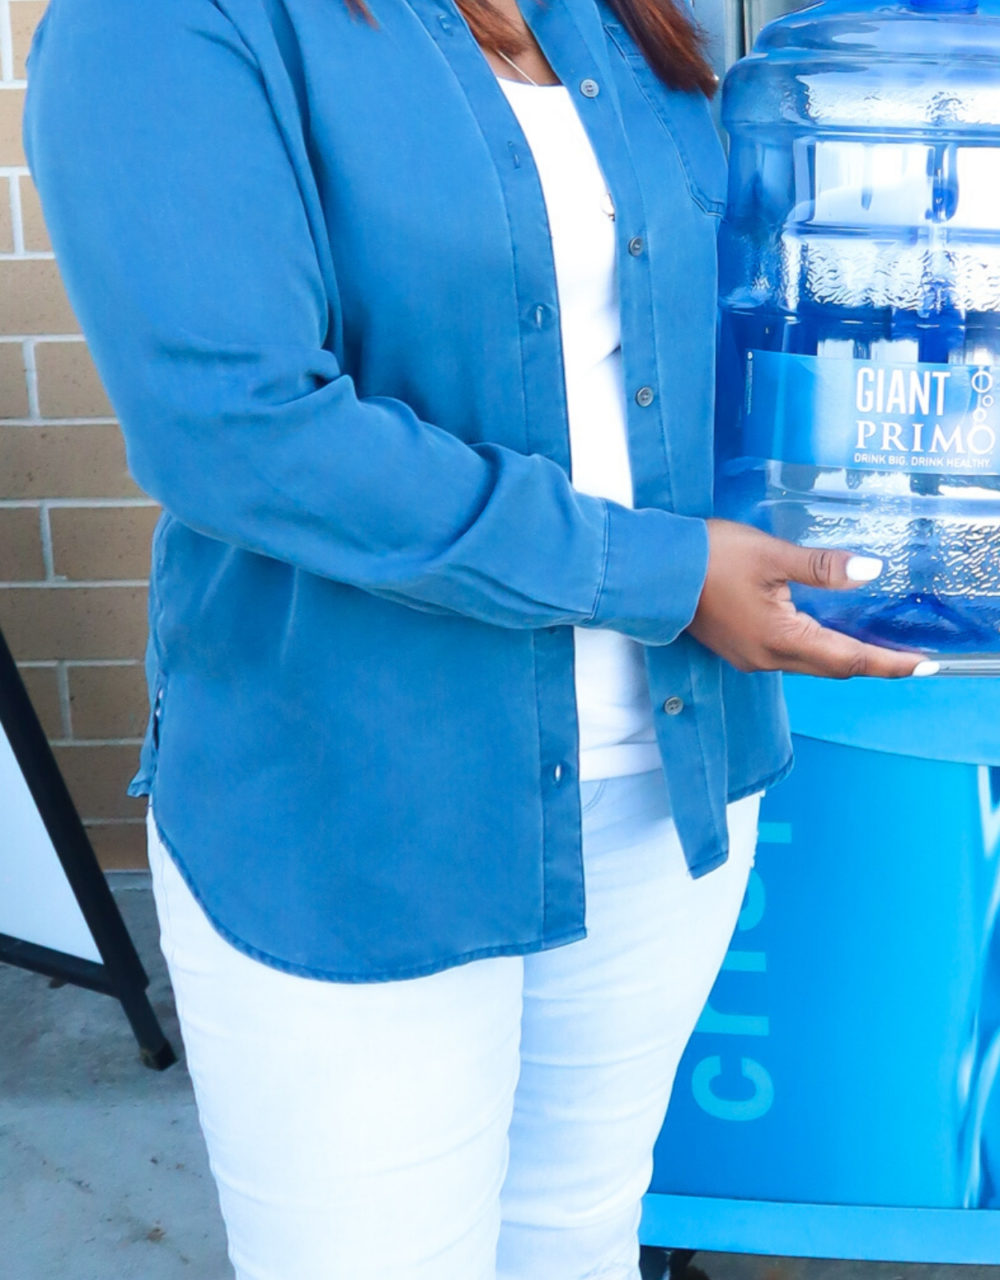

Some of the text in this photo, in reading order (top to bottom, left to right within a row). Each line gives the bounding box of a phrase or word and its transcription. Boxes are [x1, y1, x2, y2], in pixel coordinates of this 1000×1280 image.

[855, 367, 951, 417] GIANT
[855, 419, 996, 455] PRIMO
[854, 453, 886, 465] DRINK
[888, 455, 908, 466] BIG.
[911, 456, 944, 467] DRINK
